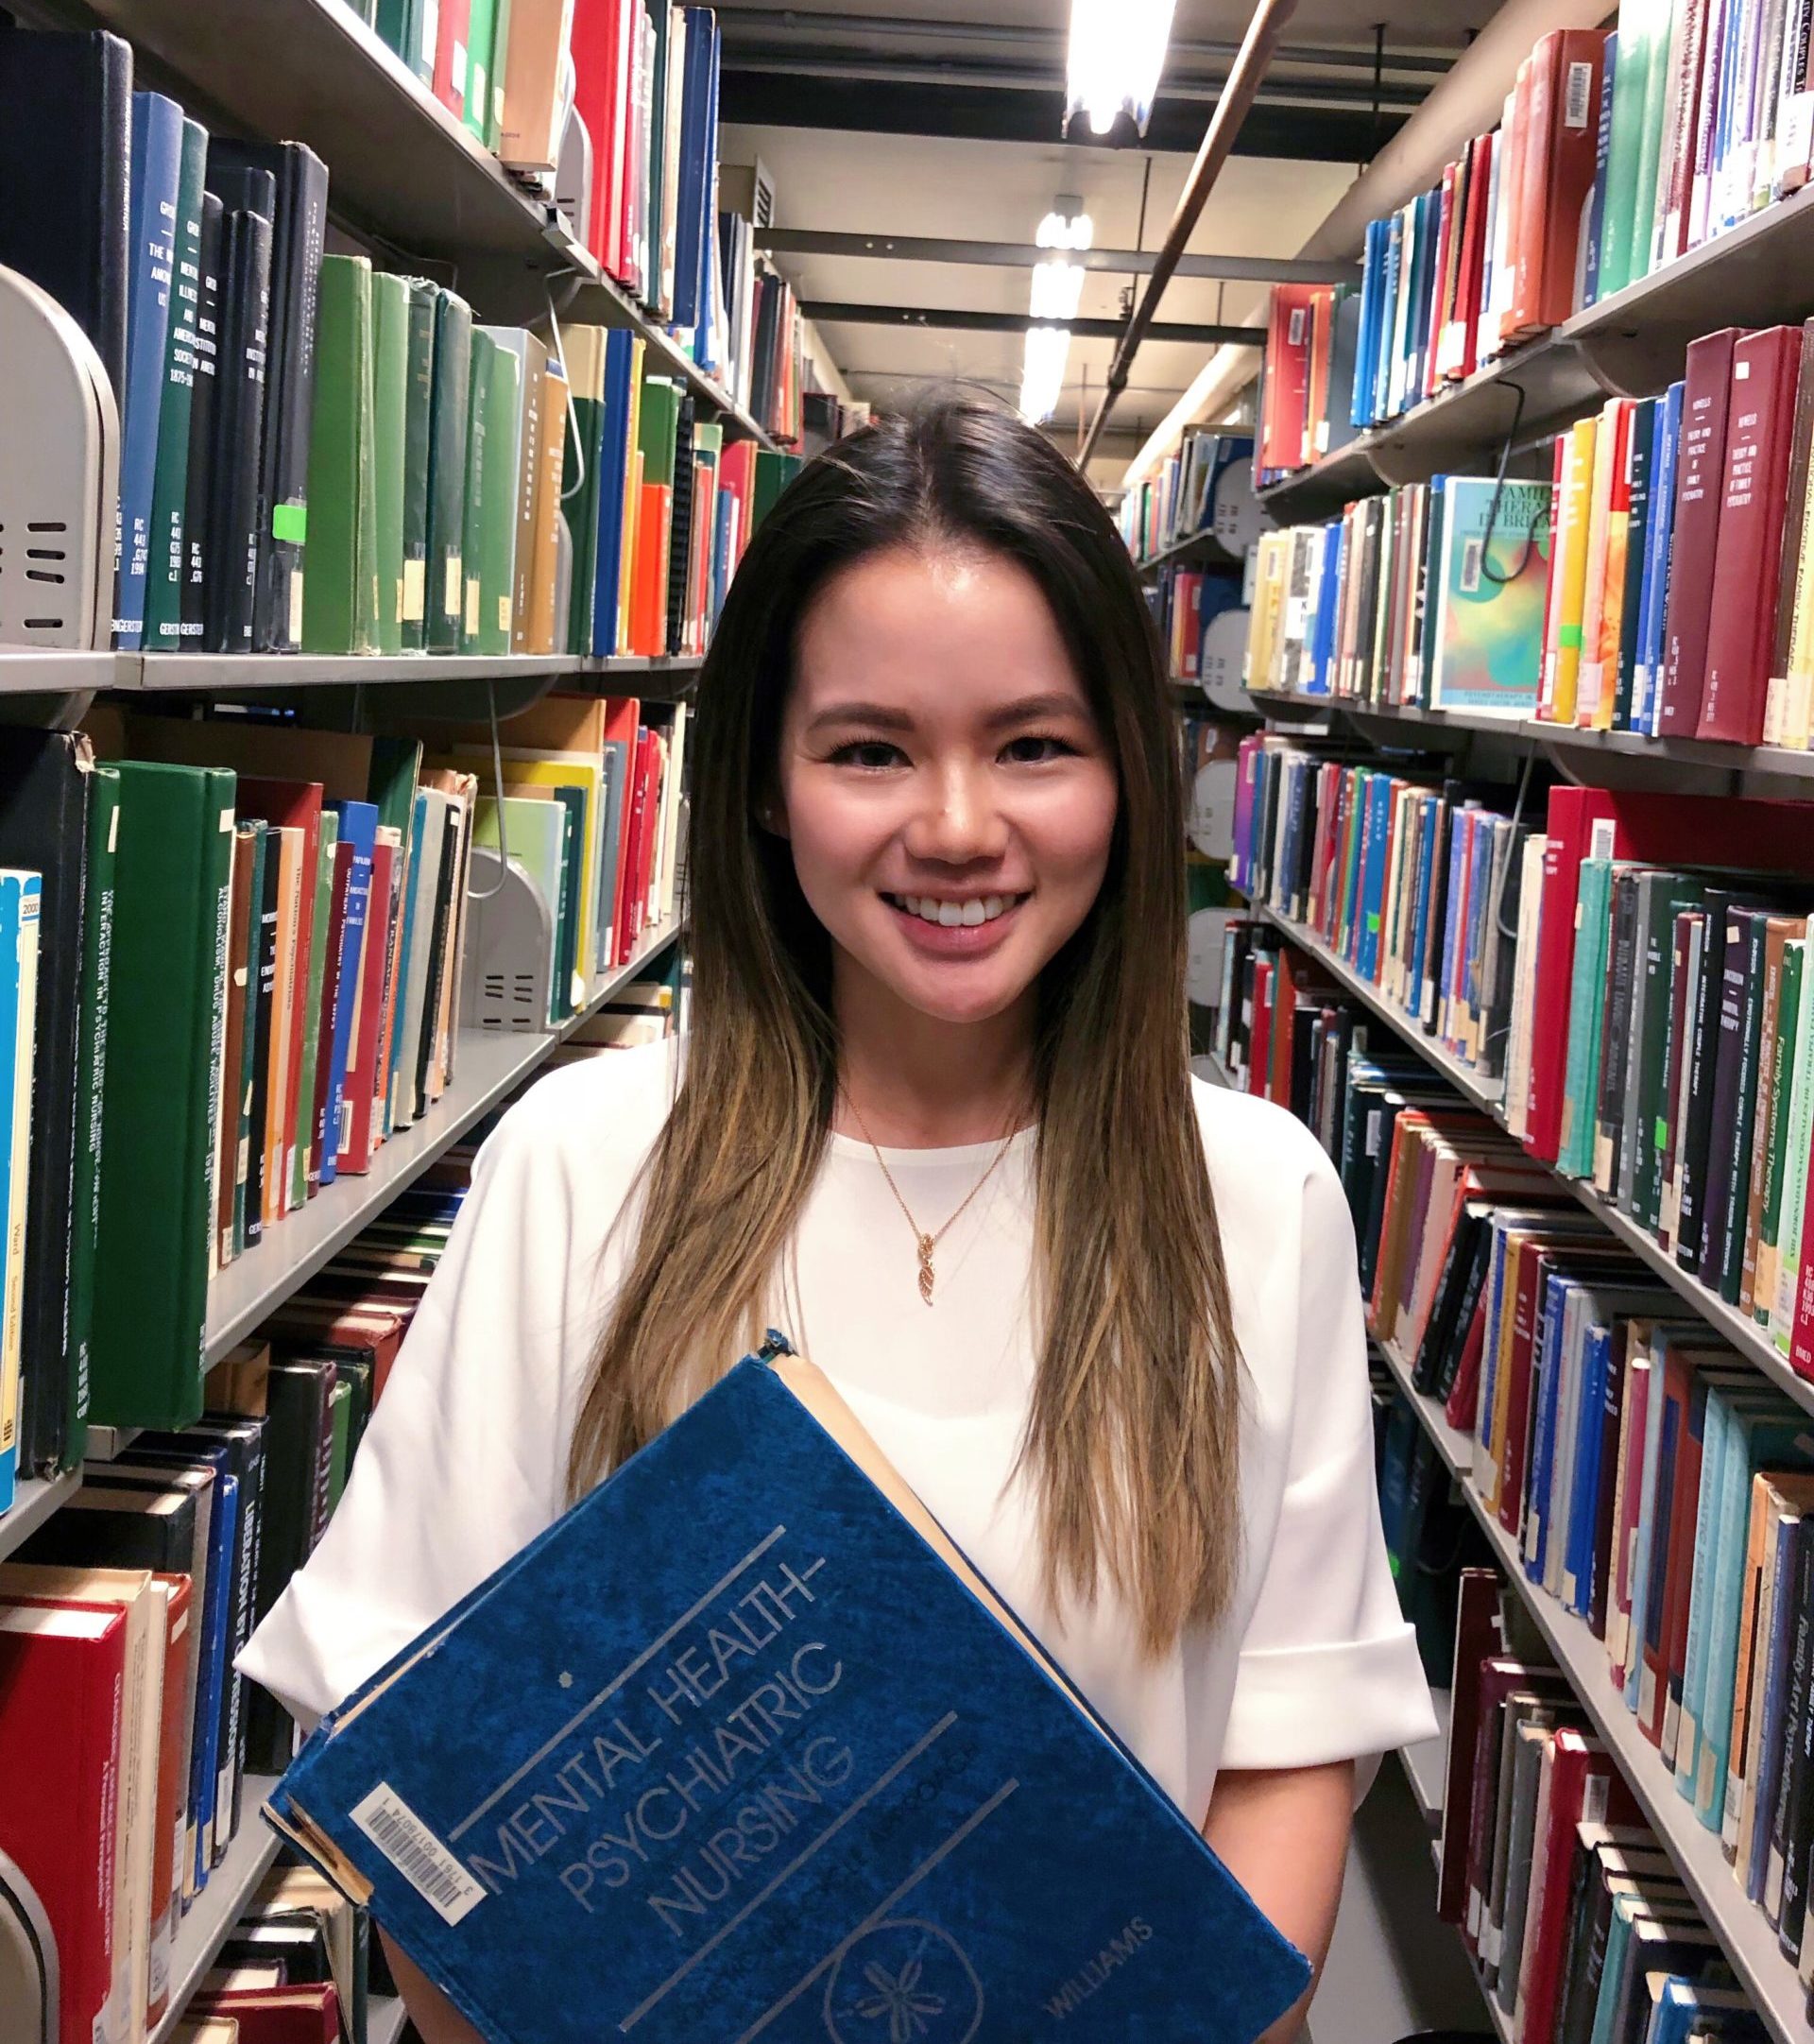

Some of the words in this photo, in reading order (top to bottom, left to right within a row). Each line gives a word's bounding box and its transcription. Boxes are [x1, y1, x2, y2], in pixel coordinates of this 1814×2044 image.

[1799, 509, 1811, 562] EMOTIVE
[1793, 567, 1805, 613] FAMILY
[1788, 614, 1799, 672] THERAPY
[344, 867, 352, 915] OUTPATIENT
[98, 890, 109, 981] INTERACTION
[338, 919, 347, 968] PSYCHIATRY
[96, 986, 104, 1001] IN
[93, 1005, 103, 1091] PSYCHIATRIC
[1744, 997, 1754, 1055] EMOTIONALLY
[1692, 1061, 1702, 1097] THERAPY
[1739, 1056, 1748, 1093] FOCUSED
[1771, 1036, 1785, 1087] Family
[88, 1094, 98, 1154] NURSING
[1766, 1087, 1782, 1150] Systems
[1733, 1131, 1742, 1167] THERAPY
[1761, 1150, 1777, 1215] Therapy
[11, 1224, 21, 1257] Ward
[237, 1501, 255, 1610] LIBERATION
[1793, 1613, 1809, 1672] Family
[1790, 1675, 1804, 1713] Art
[467, 1718, 662, 1896] MENTAL
[646, 1556, 827, 1726] HEALTH-
[383, 1797, 390, 1806] 1
[559, 1641, 843, 1913] PSYCHIATRIC
[646, 1736, 851, 1937] NURSING
[438, 1859, 462, 1884] 1761
[461, 1885, 473, 1896] 3
[1043, 1915, 1153, 2019] WILLIAMS
